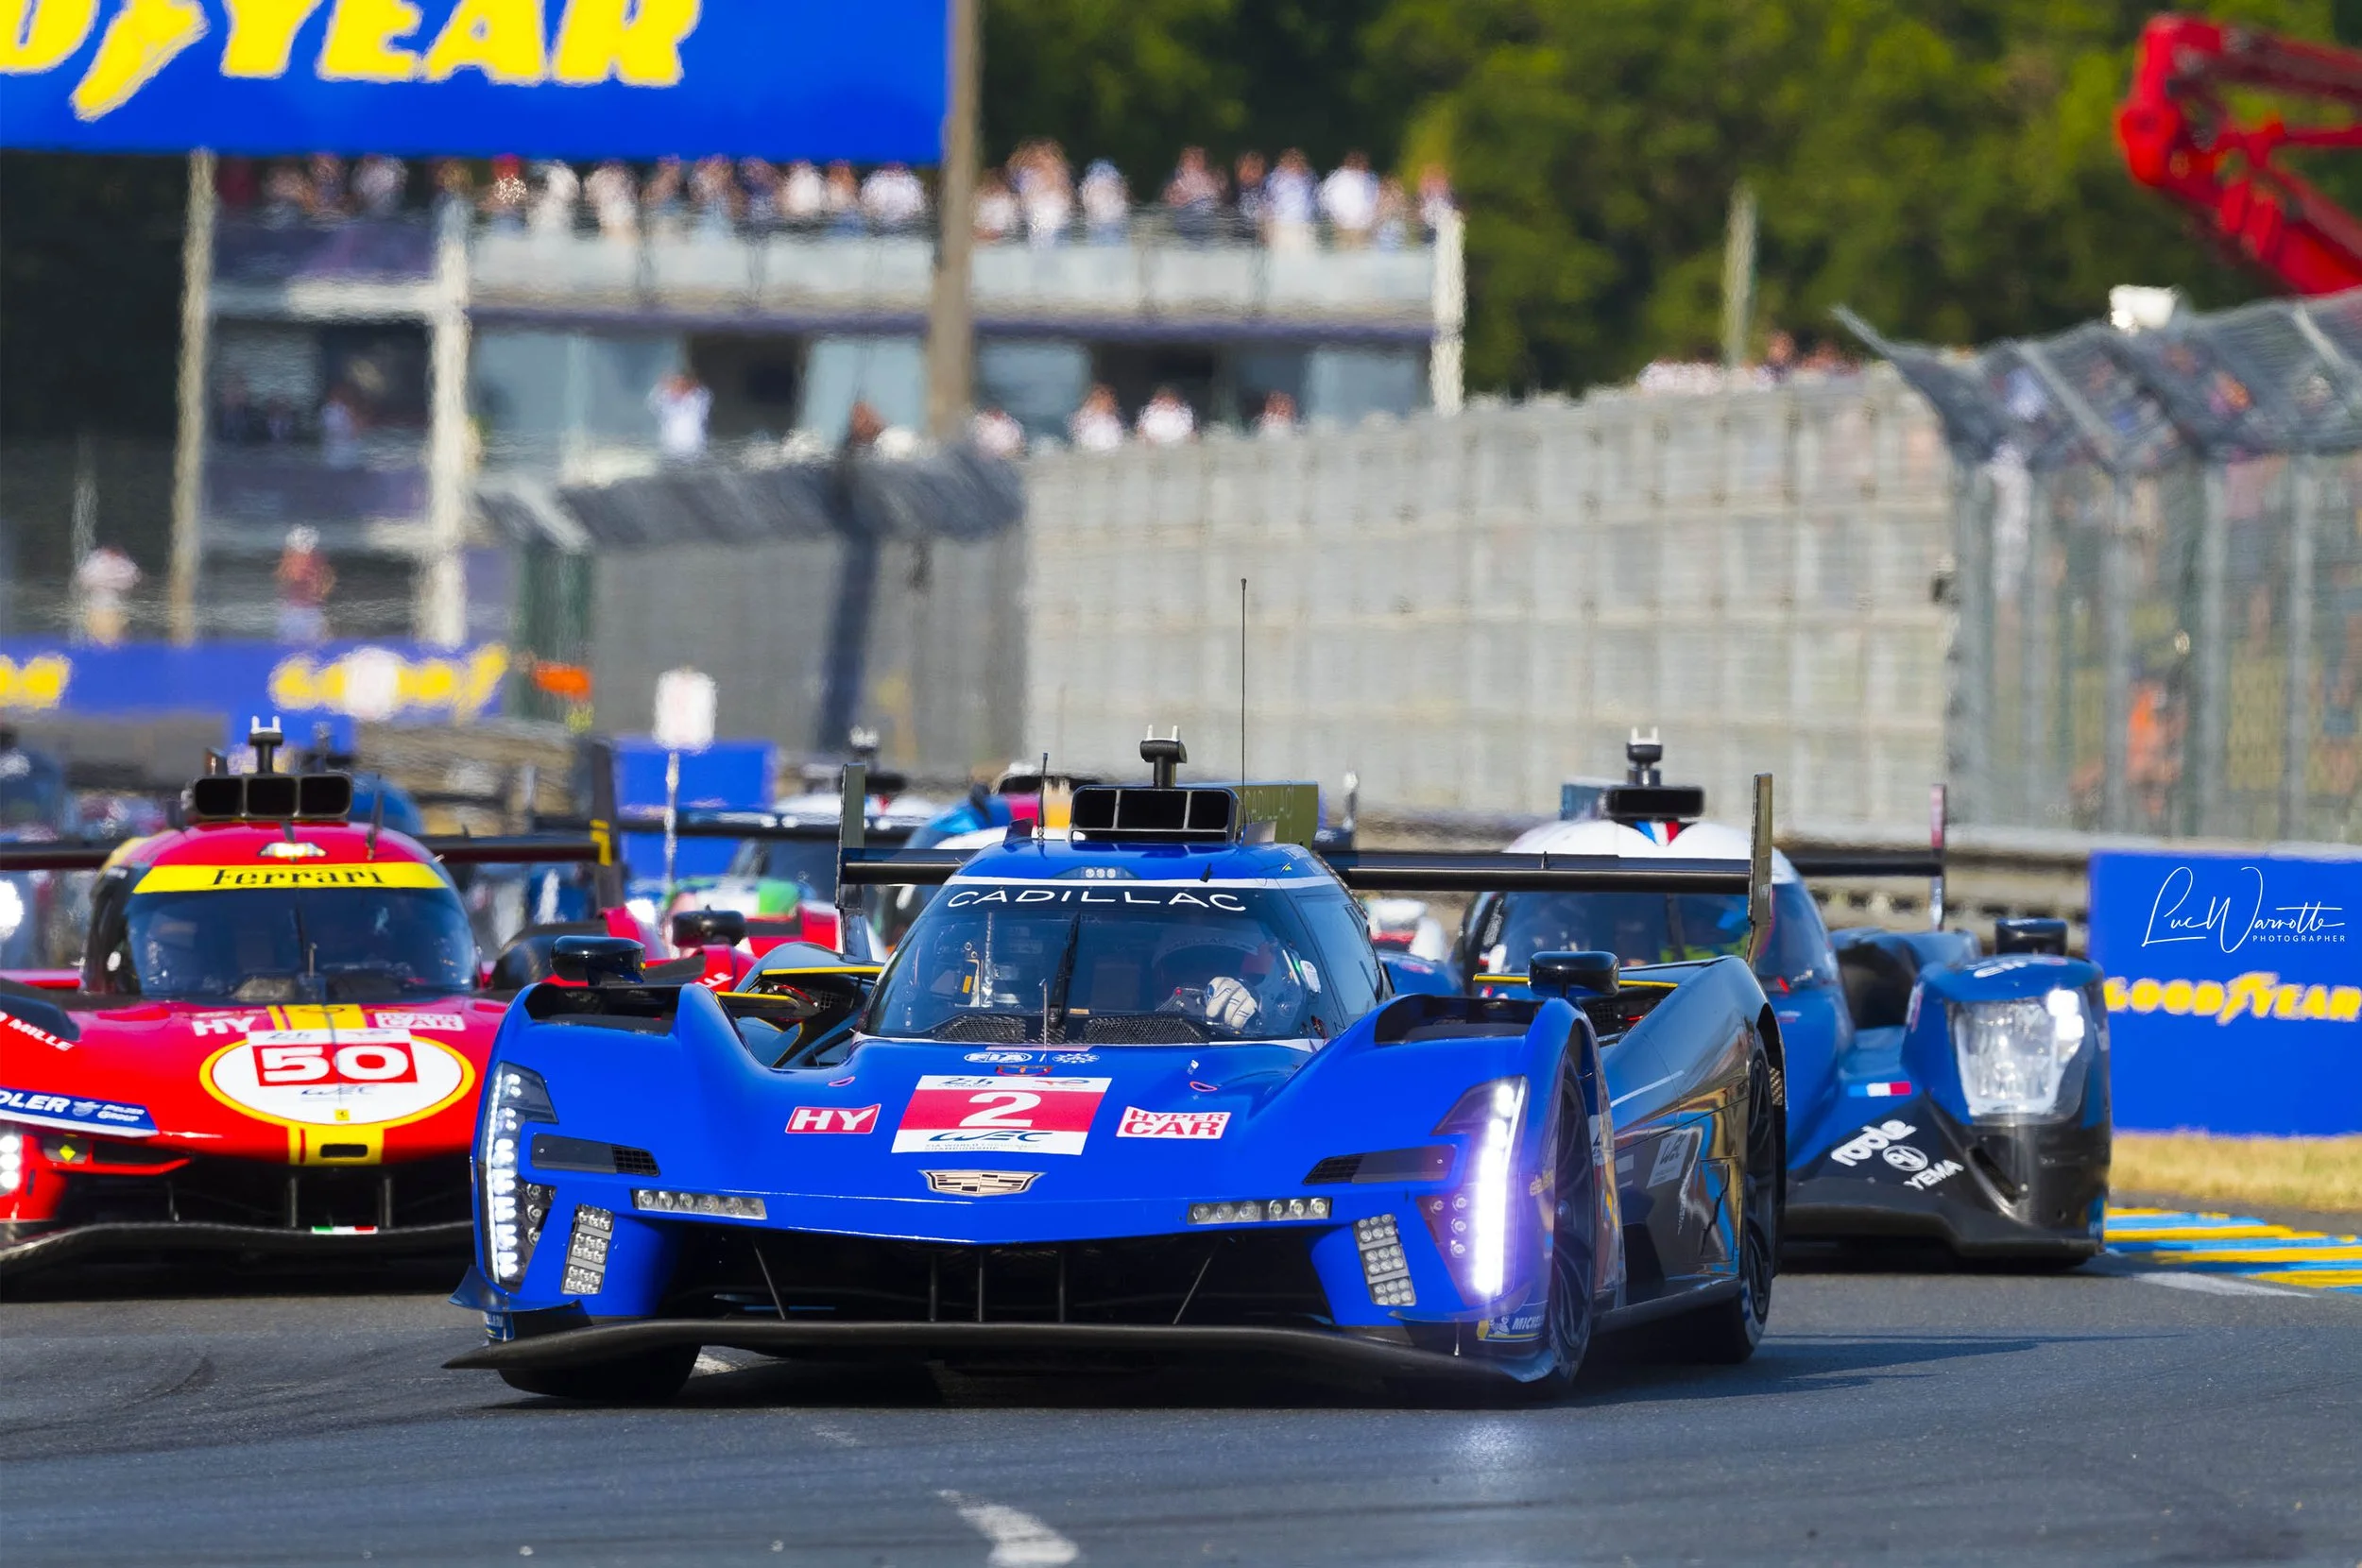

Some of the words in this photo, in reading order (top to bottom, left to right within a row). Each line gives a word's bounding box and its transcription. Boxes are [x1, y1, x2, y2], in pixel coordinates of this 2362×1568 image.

[212, 866, 385, 886] Ferrari
[948, 890, 1246, 912] CADILLAC
[8, 1018, 75, 1051] MILLE
[190, 1016, 257, 1036] HY
[261, 1046, 409, 1082] 50
[792, 1108, 877, 1131] HY
[958, 1091, 1042, 1127] 2
[1131, 1110, 1224, 1121] HYPER
[928, 1130, 1053, 1147] WEC
[1124, 1121, 1220, 1135] CAR
[1903, 1159, 1964, 1190] YEMA
